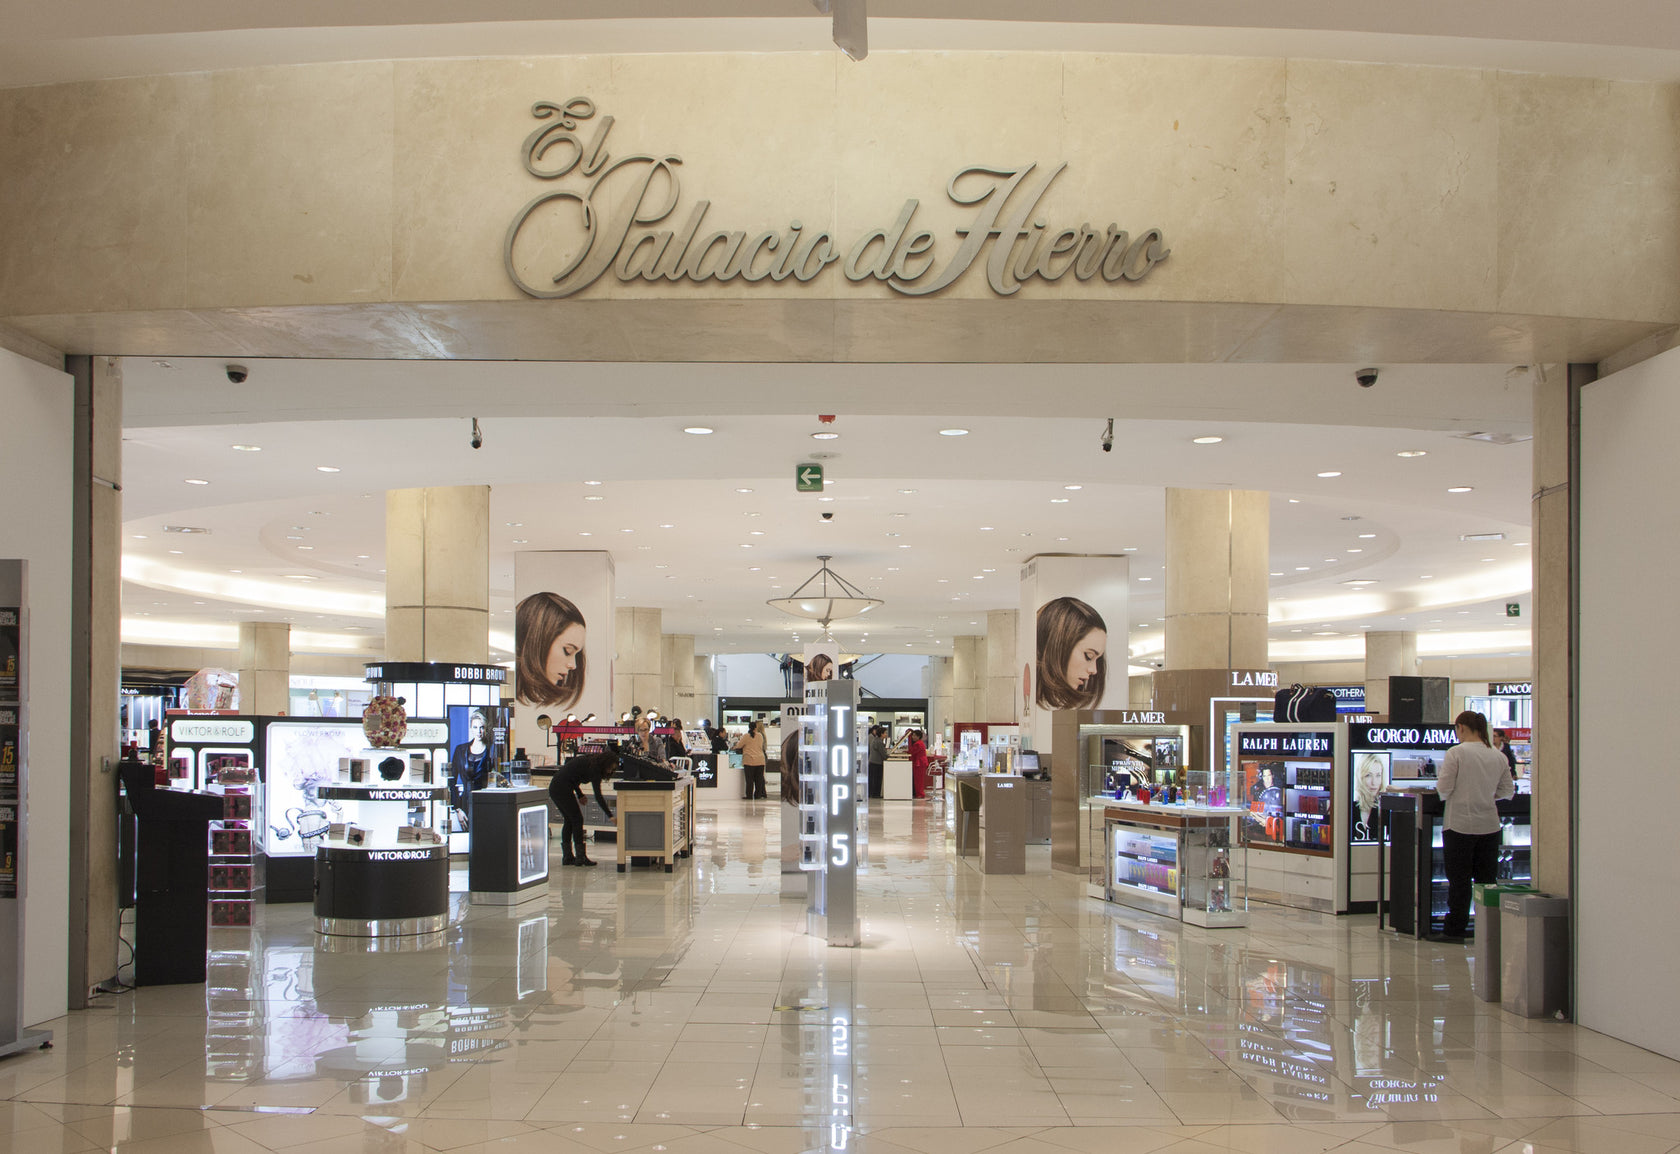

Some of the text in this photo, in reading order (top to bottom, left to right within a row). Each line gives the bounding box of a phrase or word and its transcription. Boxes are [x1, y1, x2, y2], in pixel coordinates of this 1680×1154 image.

[520, 96, 615, 179] El
[503, 153, 1170, 299] Palacio de Hierro
[454, 667, 483, 679] BOBBI
[1231, 671, 1278, 687] LA MER
[1121, 711, 1166, 724] LA MER
[1367, 728, 1460, 744] GIORGIO ARMA
[1242, 738, 1329, 751] RALPH LAUREN
[2, 745, 15, 765] 15
[830, 705, 851, 867] TOP 5
